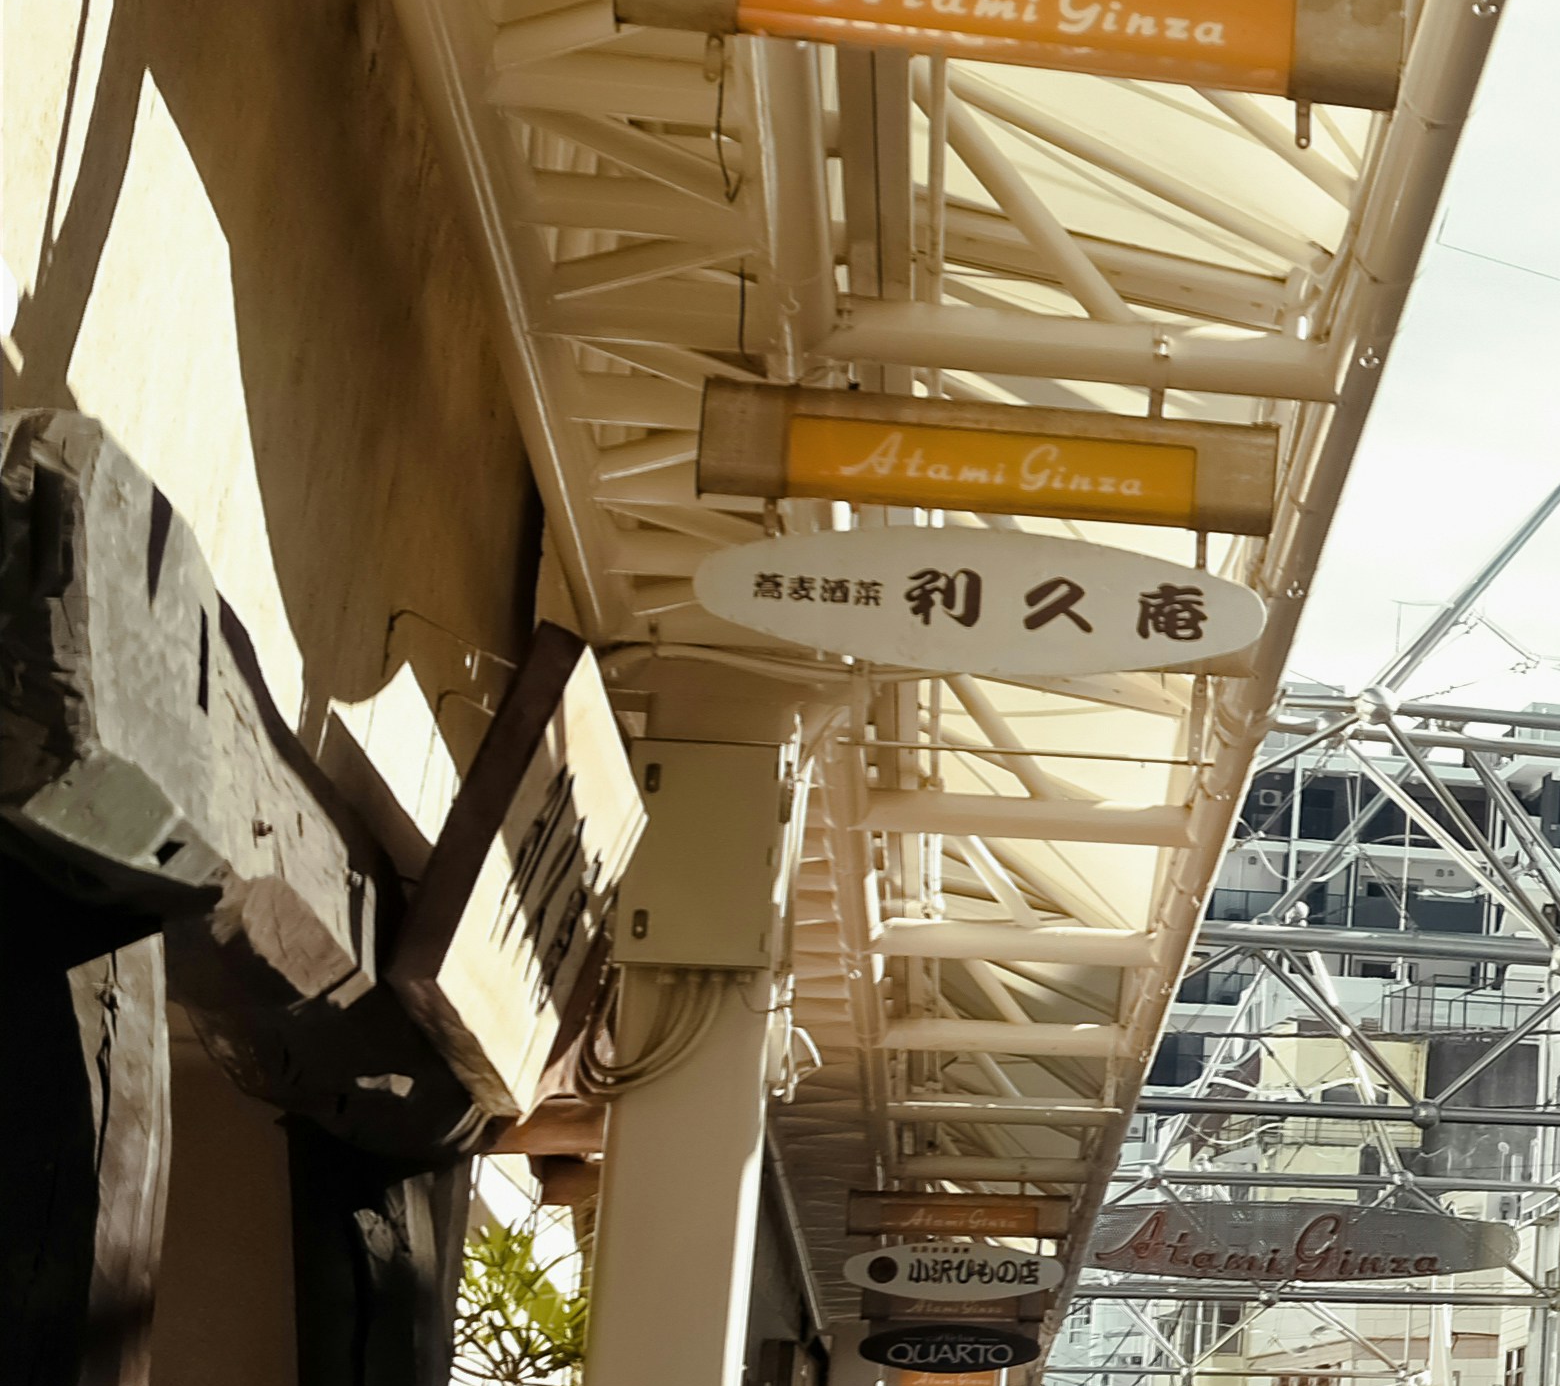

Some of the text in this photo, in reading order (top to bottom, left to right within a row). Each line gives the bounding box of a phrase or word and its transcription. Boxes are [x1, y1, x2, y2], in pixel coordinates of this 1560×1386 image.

[838, 432, 1146, 497] Atami Ginza
[753, 567, 1208, 641] 蕎麦酒菜 利久庵
[1095, 1210, 1441, 1278] Atami Ginza
[887, 1344, 1013, 1363] QUARTO
